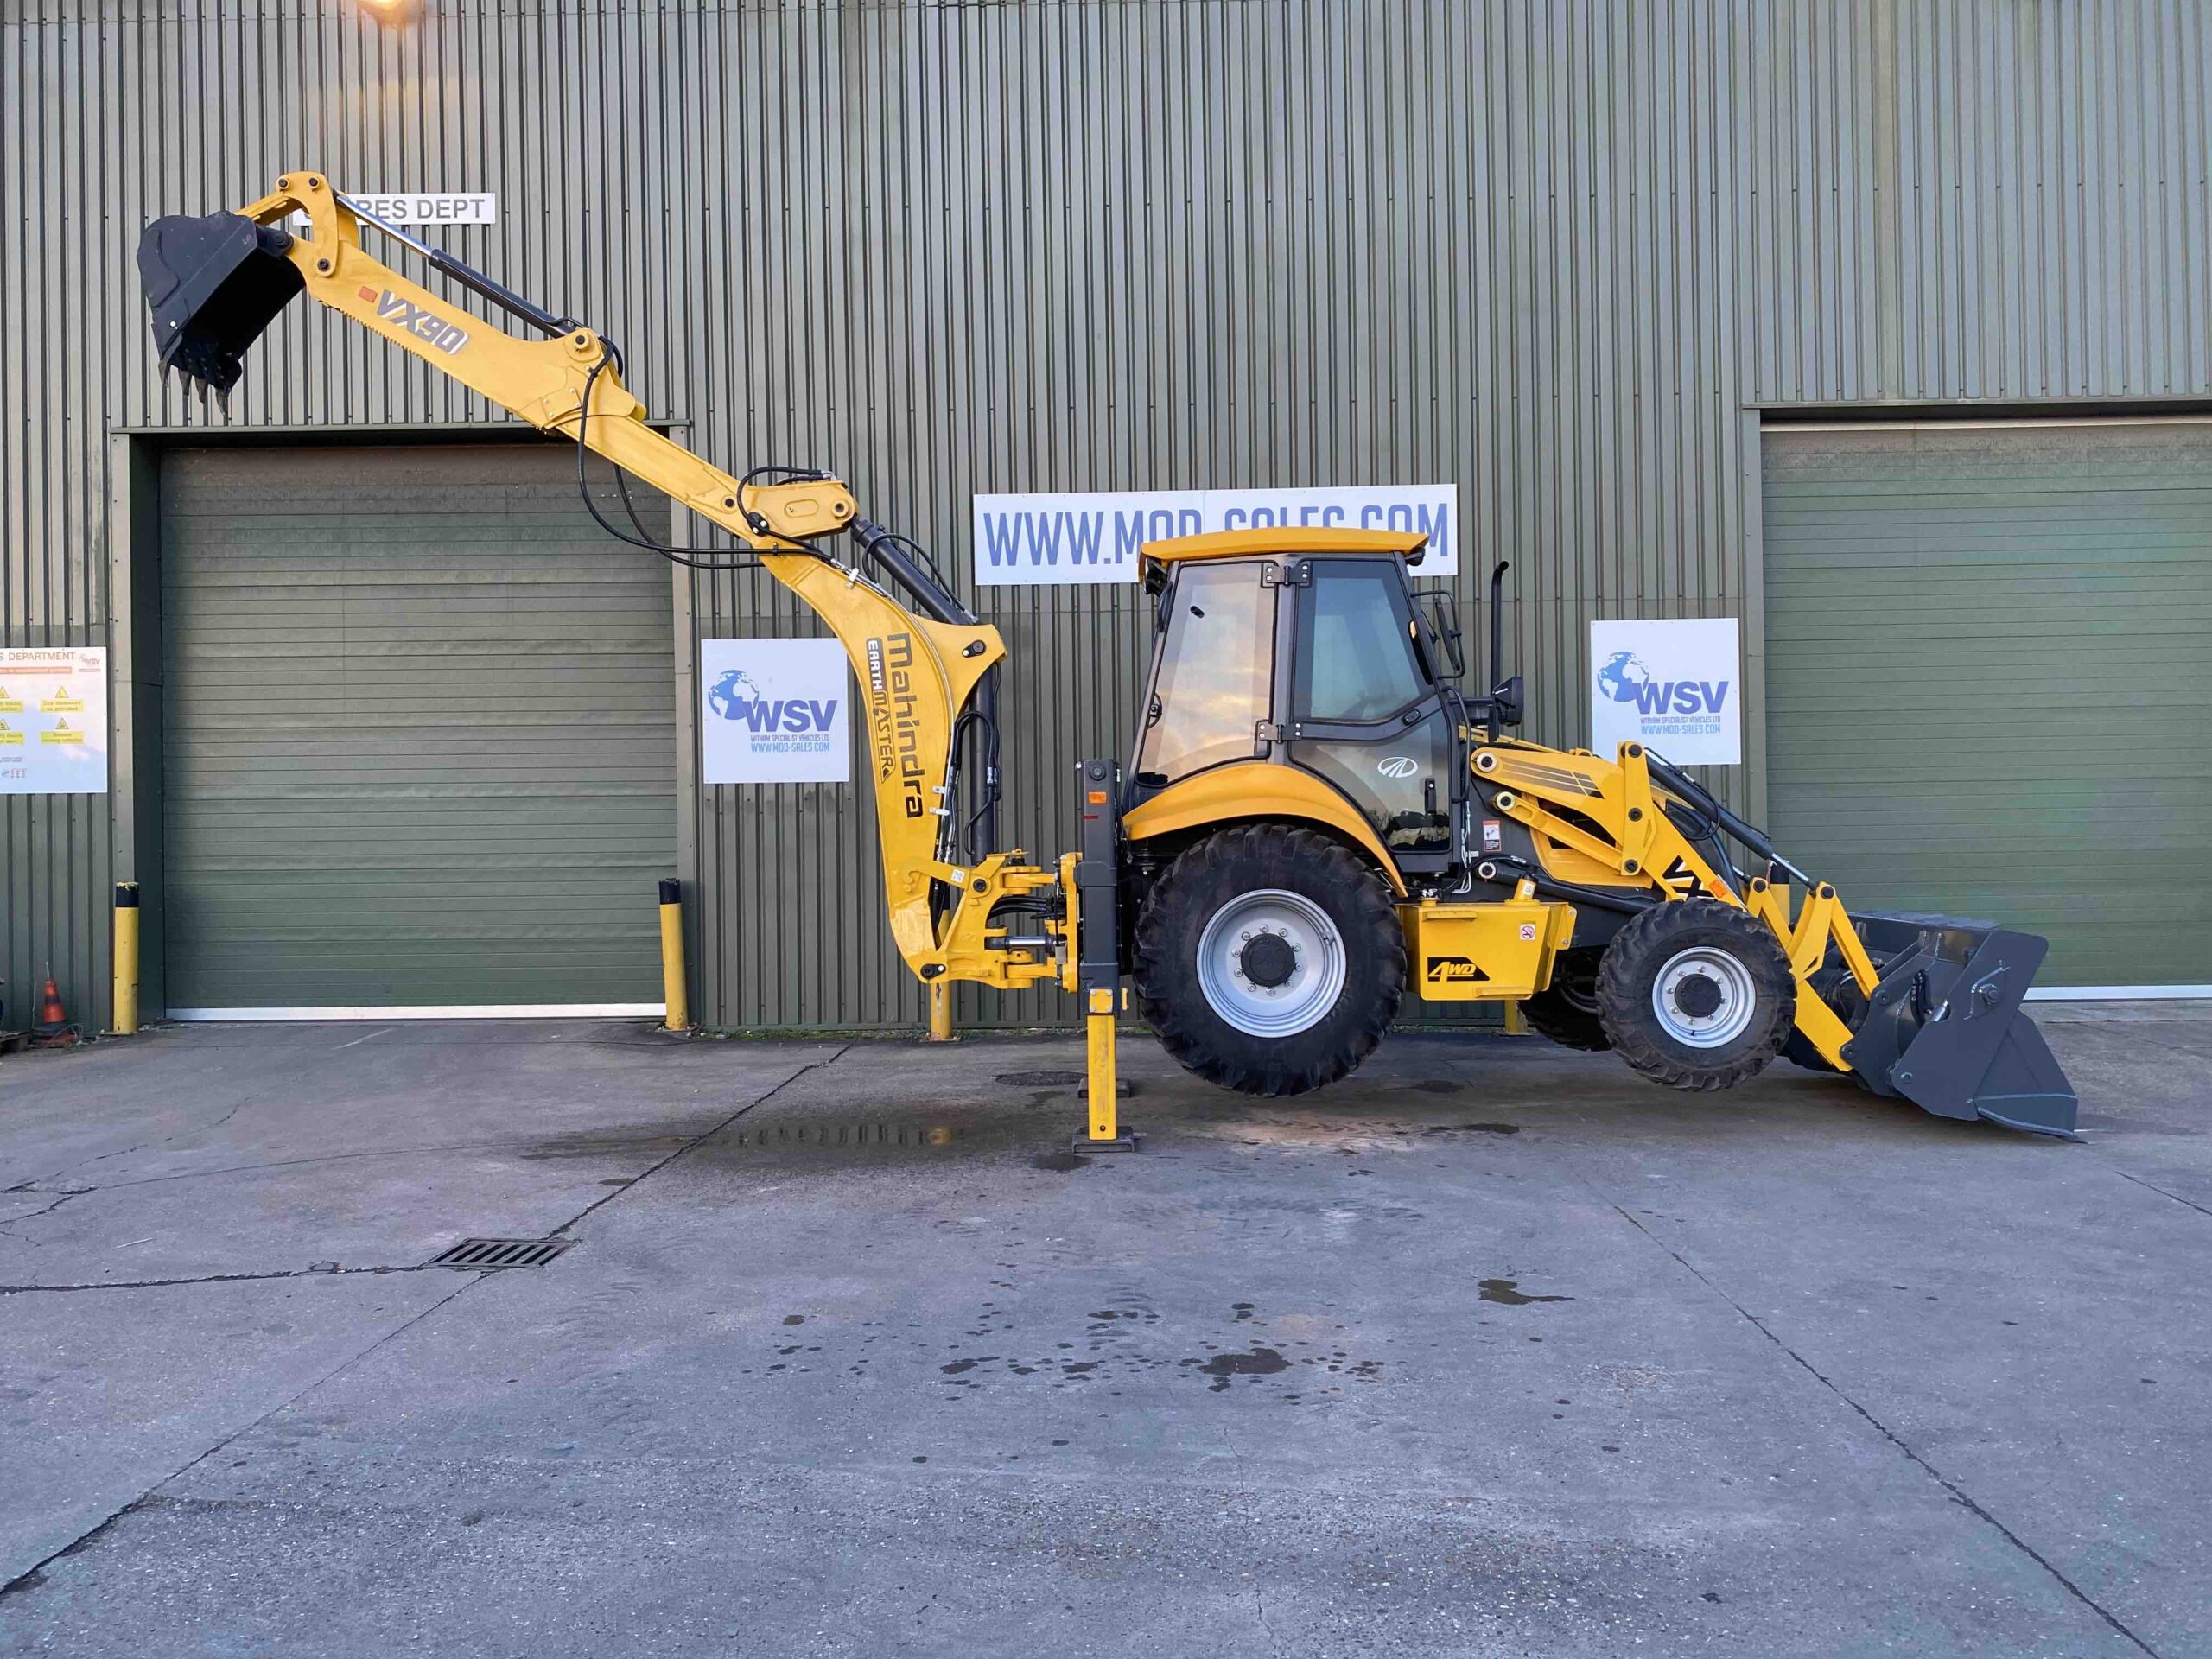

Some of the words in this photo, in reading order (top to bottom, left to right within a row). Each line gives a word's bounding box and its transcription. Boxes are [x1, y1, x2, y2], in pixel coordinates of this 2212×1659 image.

[416, 199, 486, 219] DEPT
[377, 289, 470, 355] VX90
[8, 652, 75, 661] DEPARTMENT
[1631, 681, 1729, 715] WSV
[742, 699, 837, 732] WSV
[1427, 961, 1477, 982] 4WD
